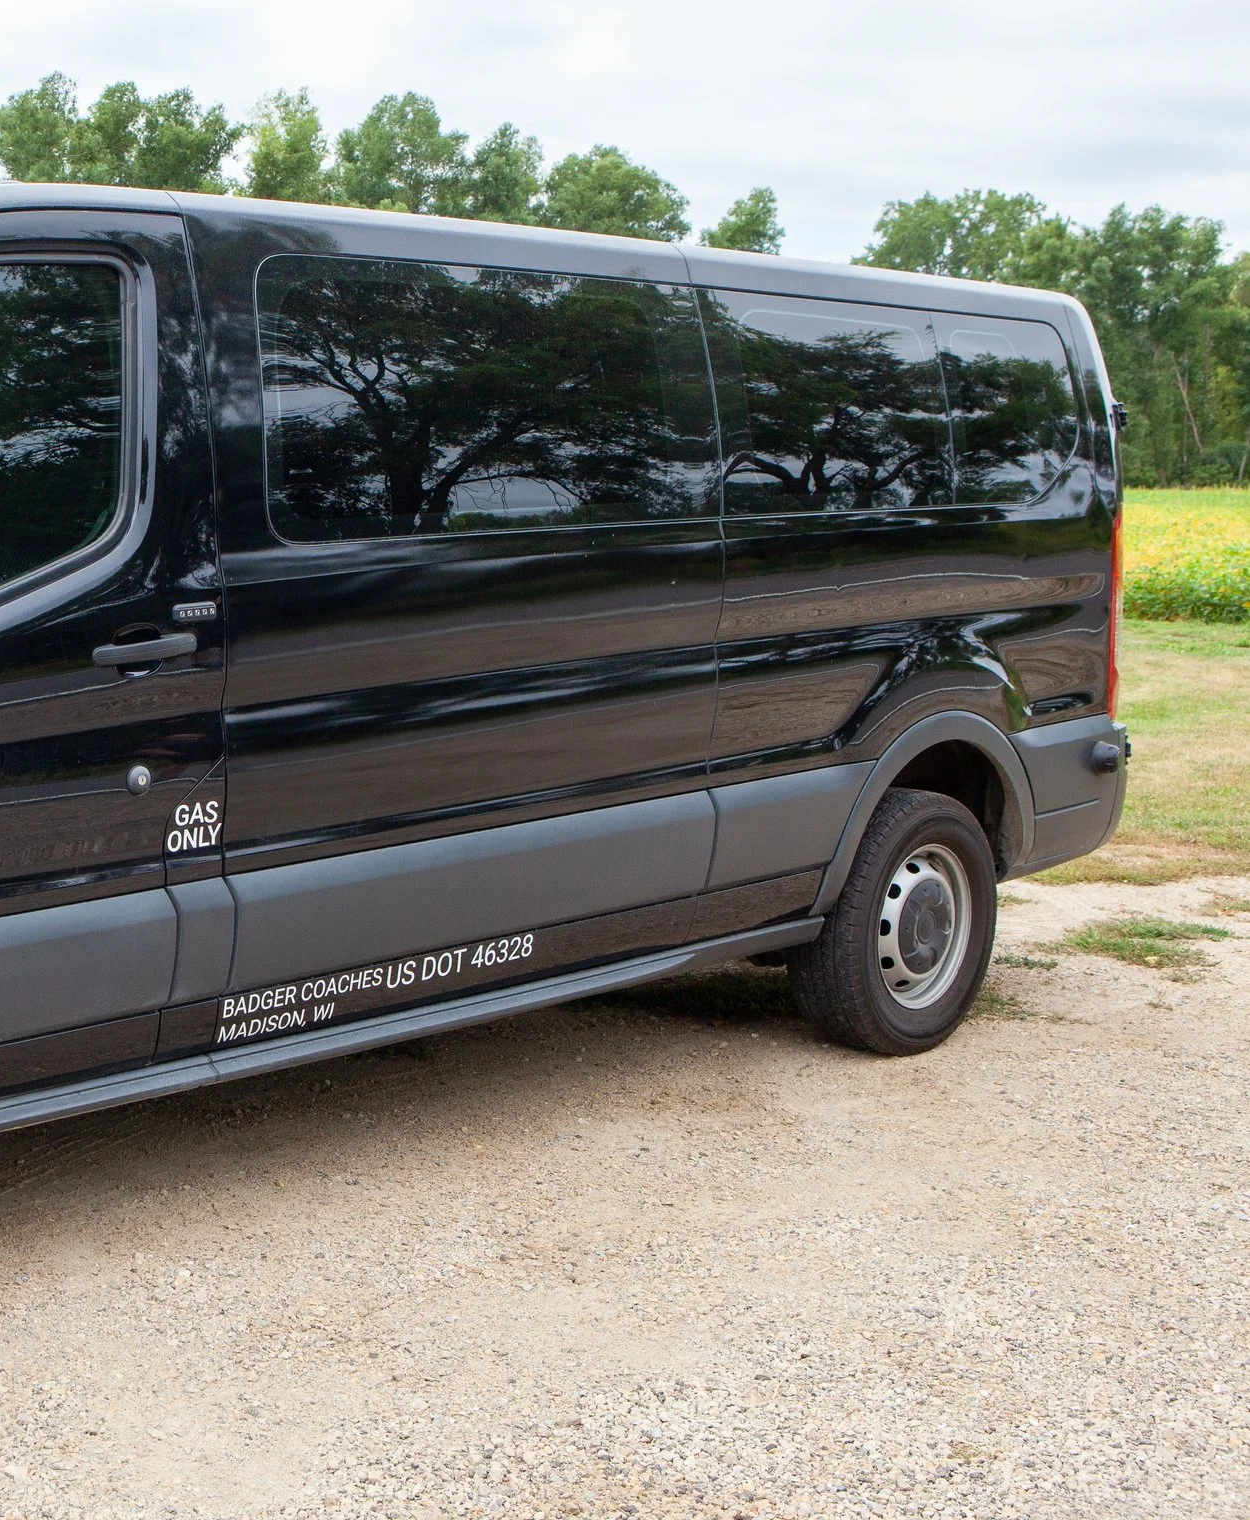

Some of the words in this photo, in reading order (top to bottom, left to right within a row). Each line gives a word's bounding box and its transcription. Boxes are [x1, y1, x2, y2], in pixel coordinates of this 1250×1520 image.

[174, 800, 219, 827] GAS
[166, 822, 223, 853] ONLY
[222, 985, 297, 1019] BADGER
[301, 967, 384, 1002] COACHES
[386, 960, 417, 989] US
[421, 948, 468, 981] DOT
[470, 933, 534, 969] 46328
[216, 1008, 307, 1043] MADISON,
[313, 1002, 335, 1022] WI
